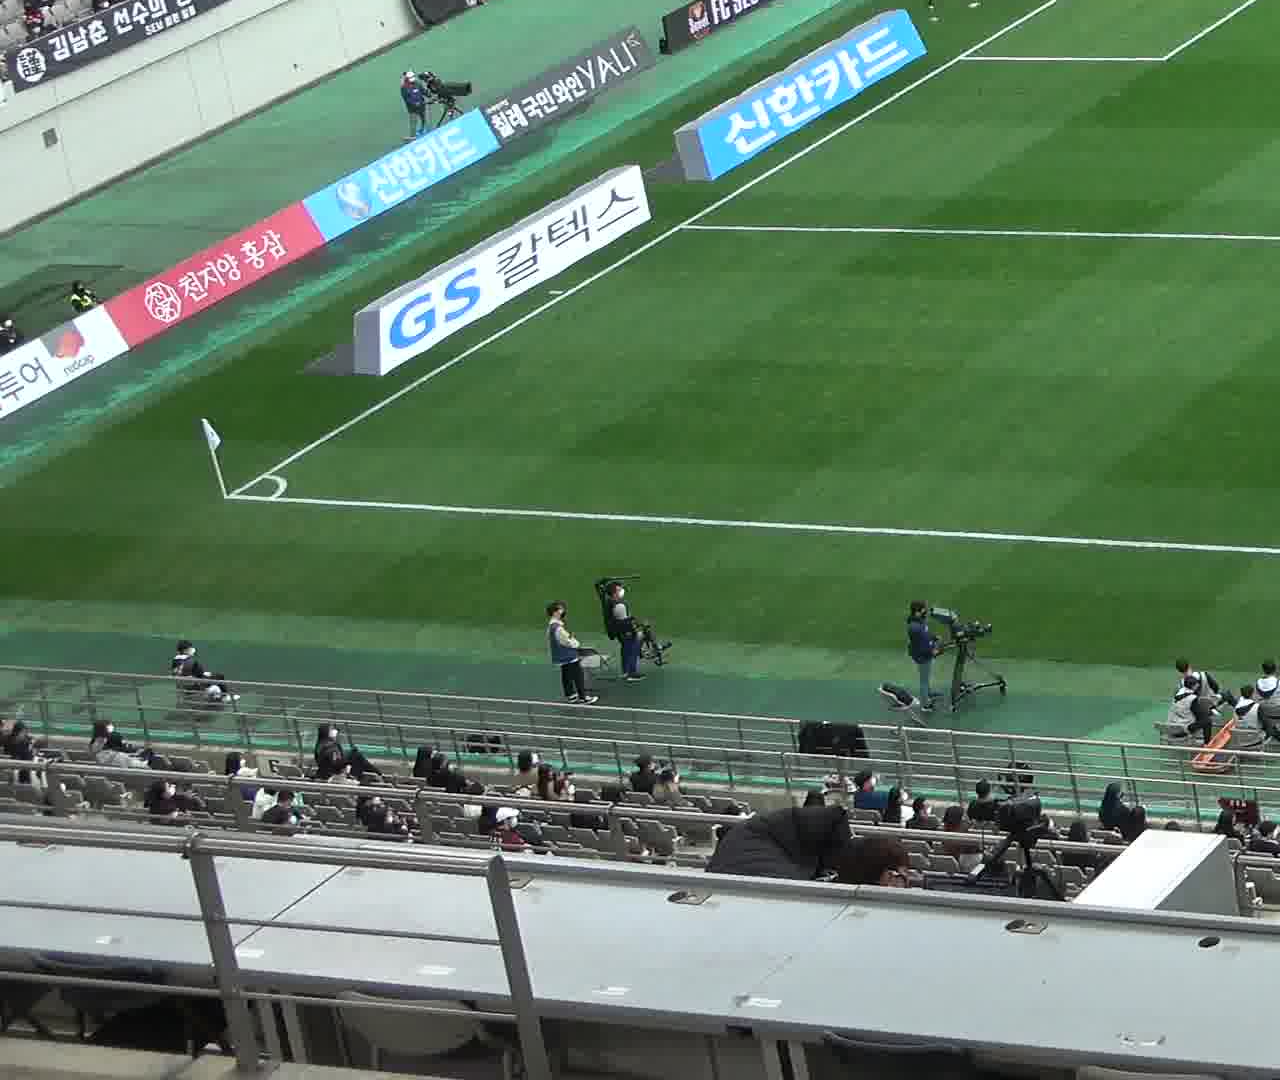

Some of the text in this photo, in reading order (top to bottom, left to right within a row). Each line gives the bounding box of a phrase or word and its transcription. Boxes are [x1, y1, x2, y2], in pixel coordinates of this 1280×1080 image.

[48, 19, 109, 62] 김남춘
[575, 41, 638, 90] YALI
[724, 25, 909, 155] 신한카드
[367, 123, 478, 204] 신한카드
[178, 253, 241, 303] 천지양
[240, 229, 288, 270] 홍삼
[389, 187, 641, 350] GS 칼텍스
